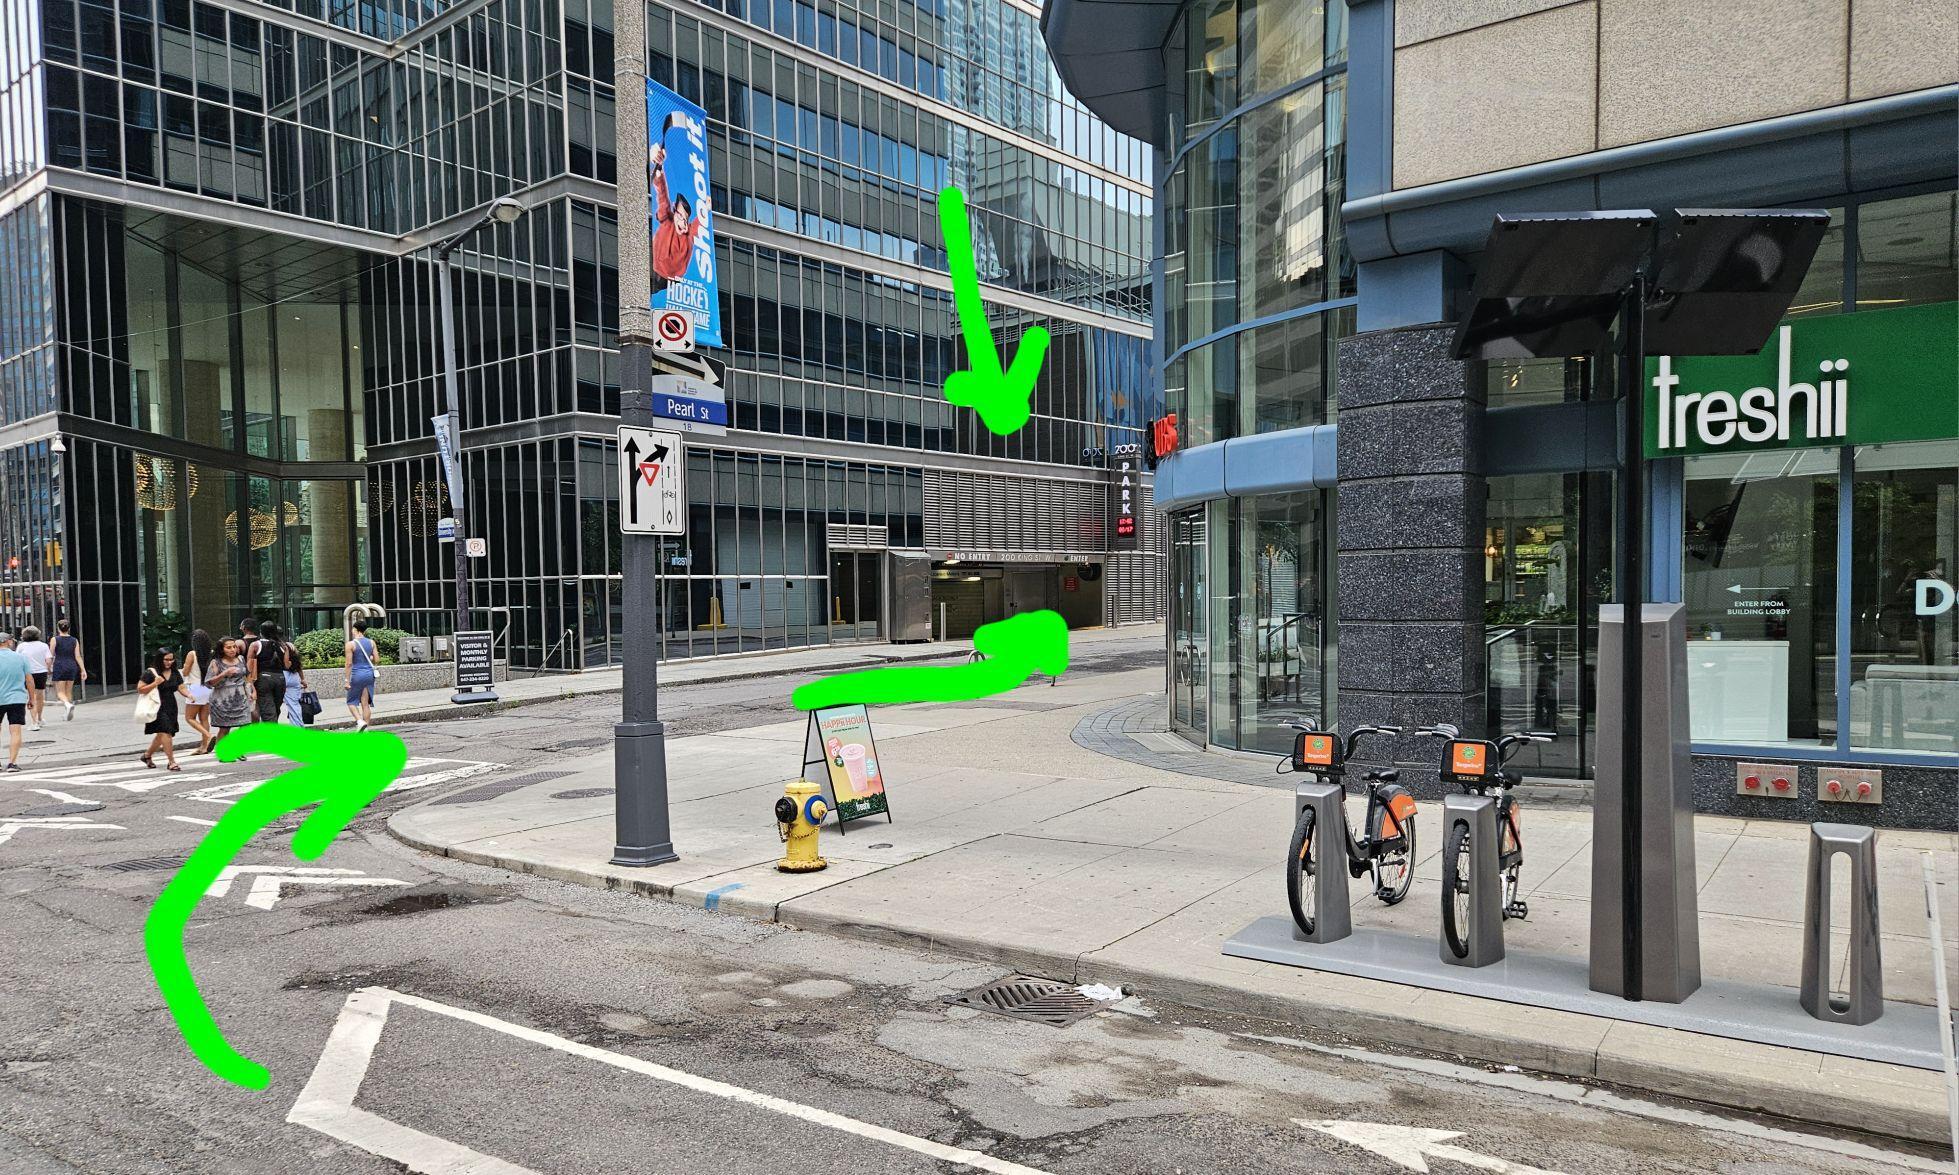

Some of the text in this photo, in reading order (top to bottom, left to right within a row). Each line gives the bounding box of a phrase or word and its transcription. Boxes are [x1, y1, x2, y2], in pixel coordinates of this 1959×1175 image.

[689, 152, 712, 283] shoot
[666, 279, 709, 310] HOCKEY
[667, 398, 709, 420] Pearl St
[1114, 443, 1135, 454] 200
[1121, 462, 1131, 514] PARK
[968, 553, 991, 561] ENTRY
[1001, 553, 1015, 561] 200
[1915, 579, 1959, 616] D
